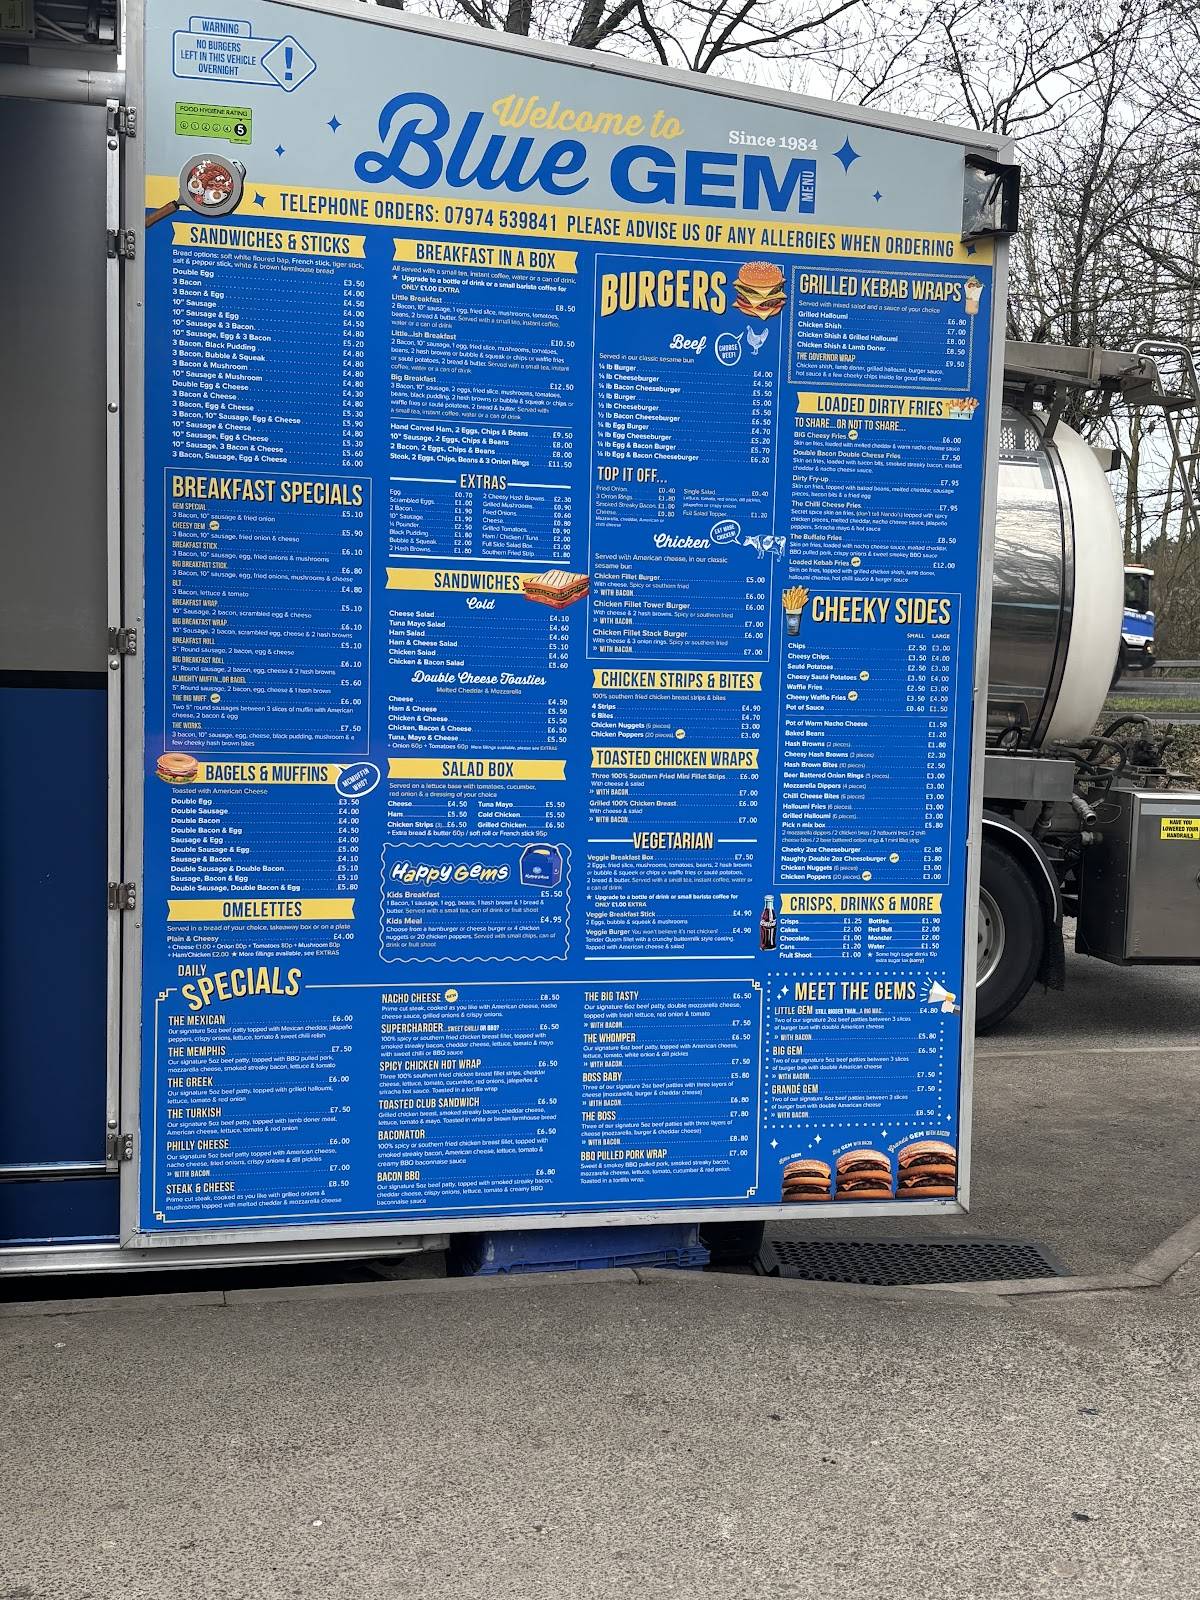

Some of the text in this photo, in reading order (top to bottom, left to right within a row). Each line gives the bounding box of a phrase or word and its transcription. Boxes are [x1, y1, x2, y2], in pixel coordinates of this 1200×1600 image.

[202, 21, 239, 34] WARNING
[197, 40, 241, 52] NO BURGERS
[181, 51, 198, 59] LEFT
[209, 53, 225, 62] THIS
[227, 55, 256, 65] VEHICLE
[199, 64, 238, 75] OVERNIGHT
[491, 93, 684, 139] Welcome to
[238, 126, 244, 134] 5
[354, 91, 589, 194] Blue
[729, 130, 818, 151] Since 1984
[610, 144, 817, 214] GEM
[802, 171, 814, 202] MENU
[280, 193, 953, 257] TELEPHONE ORDERS: 07974 539841 PLEASE ADVISE US OF ANY ALLERGIES WHEN ORDERING
[191, 227, 350, 253] SANDWICHES & STICKS
[416, 243, 555, 269] BREAKFAST IN A BOX
[173, 268, 198, 276] Double
[601, 270, 727, 317] BURGERS
[800, 274, 962, 301] GRILLED KEBAB WRAPS
[410, 295, 442, 303] Breakfast
[670, 334, 706, 354] Beef
[186, 371, 216, 379] Sausage
[225, 373, 262, 381] Mushroom
[818, 396, 943, 416] LOADED DIRTY FRIES
[795, 417, 804, 426] TO
[849, 420, 862, 429] NOT
[864, 420, 873, 430] TO
[239, 454, 252, 462] Egg
[598, 466, 619, 481] TOP
[623, 467, 633, 481] IT
[461, 474, 506, 490] EXTRAS
[173, 476, 363, 506] BREAKFAST SPECIALS
[654, 533, 711, 549] Chicken
[435, 572, 520, 590] SANDWICHES
[466, 597, 496, 610] Cold
[812, 596, 951, 624] CHEEKY SIDES
[411, 670, 546, 685] Double Cheese Toasties
[601, 671, 754, 689] CHICKEN STRIPS & BITES
[597, 750, 753, 766] TOASTED CHICKEN WRAPS
[206, 765, 328, 781] BAGELS & MUFFINS
[443, 761, 514, 777] SALAD BOX
[342, 768, 370, 787] MCMUFFIN
[352, 780, 368, 791] WHO?
[633, 832, 713, 849] VEGETARIAN
[392, 863, 509, 886] Happy Gems
[223, 902, 302, 917] OMELETTES
[791, 897, 933, 912] CRISPS, DRINKS & MORE
[178, 965, 206, 976] DAILY
[182, 967, 302, 1011] SPECIALS
[585, 992, 599, 1001] THE
[601, 992, 613, 1000] BIG
[616, 992, 638, 1000] TASTY
[795, 982, 916, 1000] MEET THE GEMS
[382, 994, 409, 1003] NACHO
[411, 993, 441, 1003] CHEESE
[169, 1016, 185, 1025] THE
[187, 1015, 225, 1025] MEXICAN
[773, 1047, 786, 1055] BIG
[787, 1046, 802, 1055] GEM
[380, 1059, 481, 1071] SPICY CHICKEN HOT WRAP
[803, 1084, 818, 1093] GEM
[378, 1130, 425, 1141] BACONATOR
